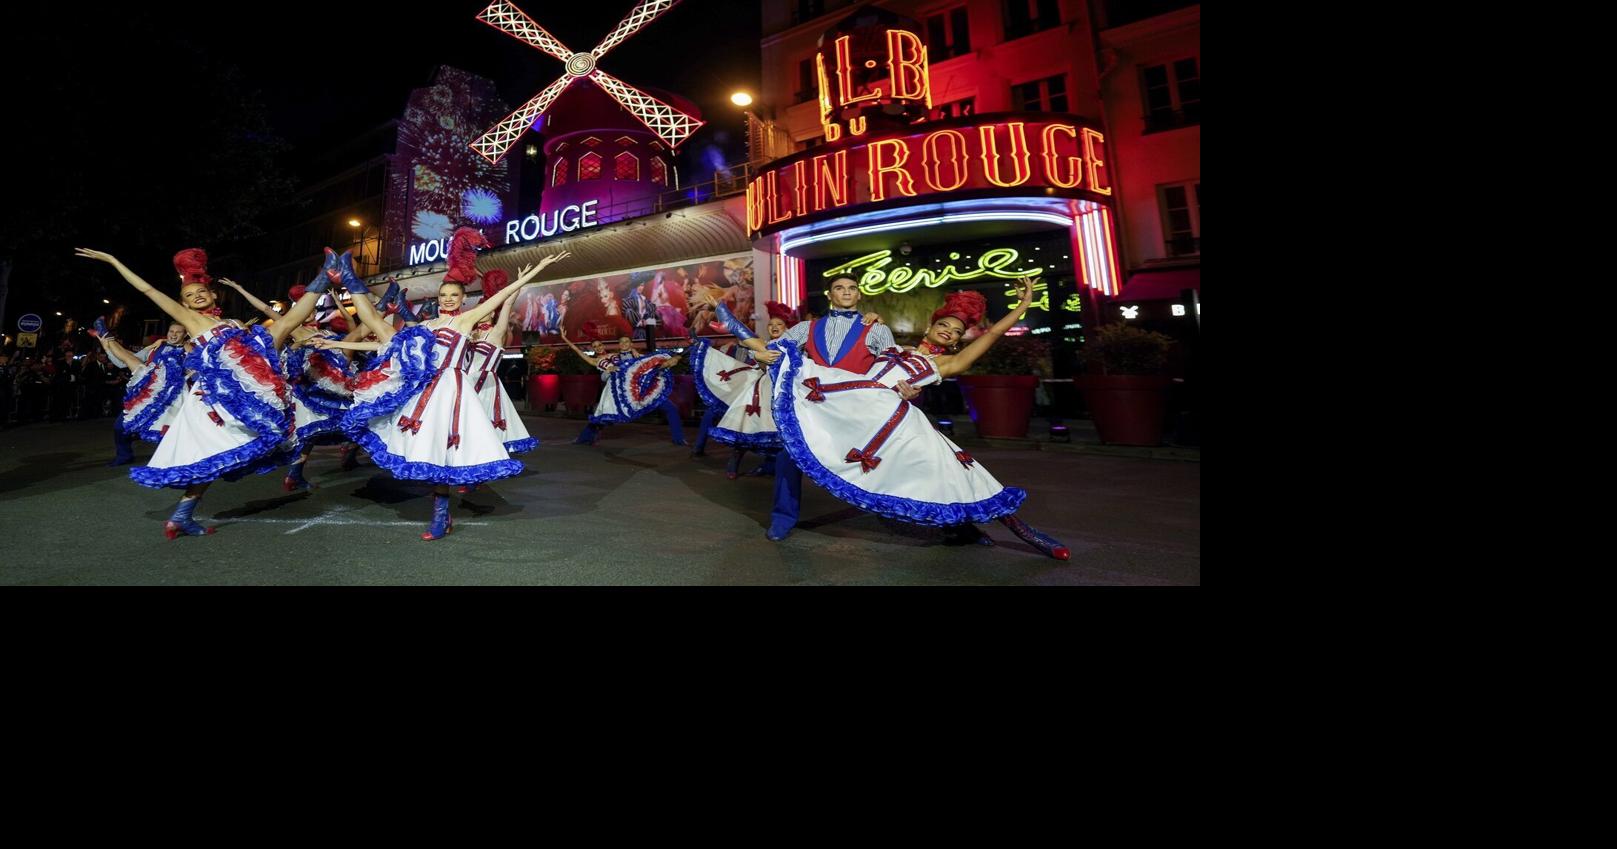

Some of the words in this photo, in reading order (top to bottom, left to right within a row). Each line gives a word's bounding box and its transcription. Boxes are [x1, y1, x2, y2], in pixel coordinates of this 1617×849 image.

[746, 150, 848, 238] ULIN
[867, 122, 1112, 202] ROUGE
[505, 199, 598, 244] ROUGE
